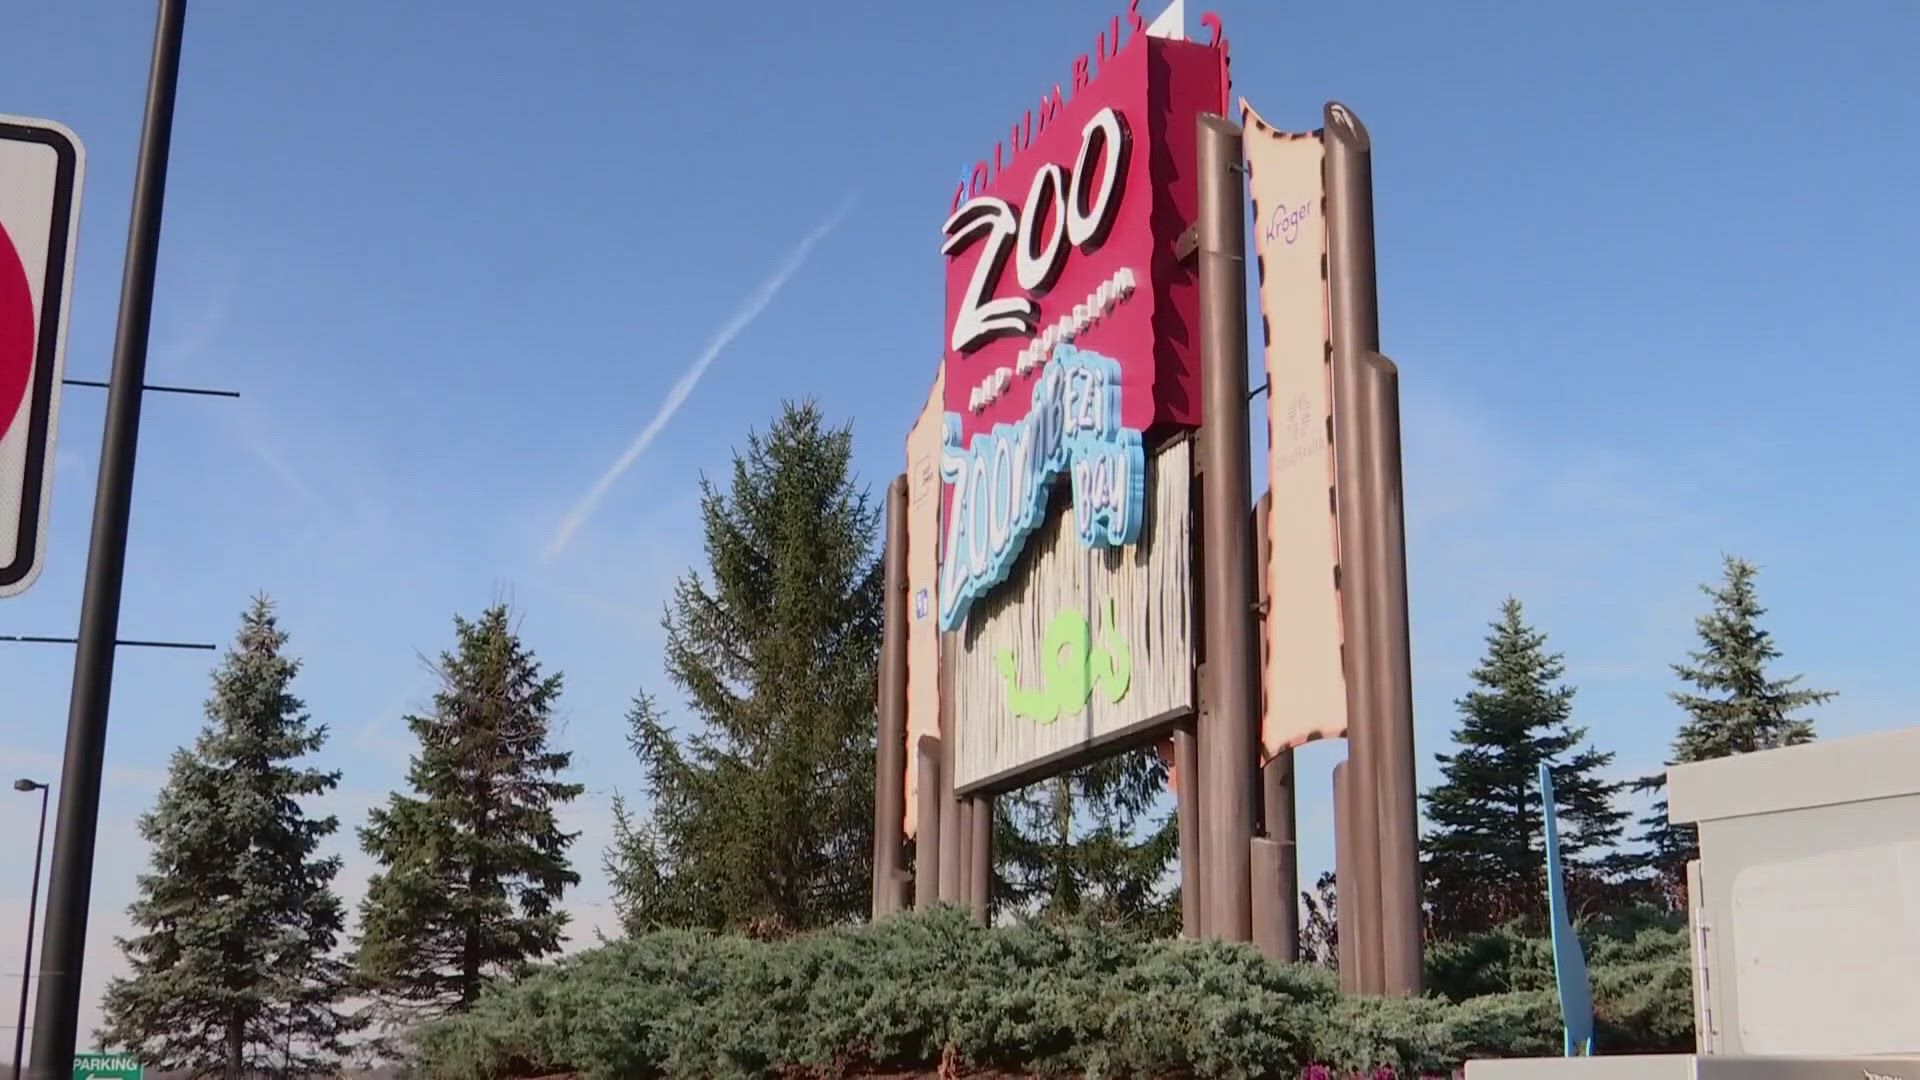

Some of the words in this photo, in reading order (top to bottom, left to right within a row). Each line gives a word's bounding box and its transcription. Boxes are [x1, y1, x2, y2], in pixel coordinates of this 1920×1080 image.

[941, 107, 1127, 353] ZOO
[1266, 201, 1311, 245] Kroger
[74, 1057, 138, 1071] PARKING
